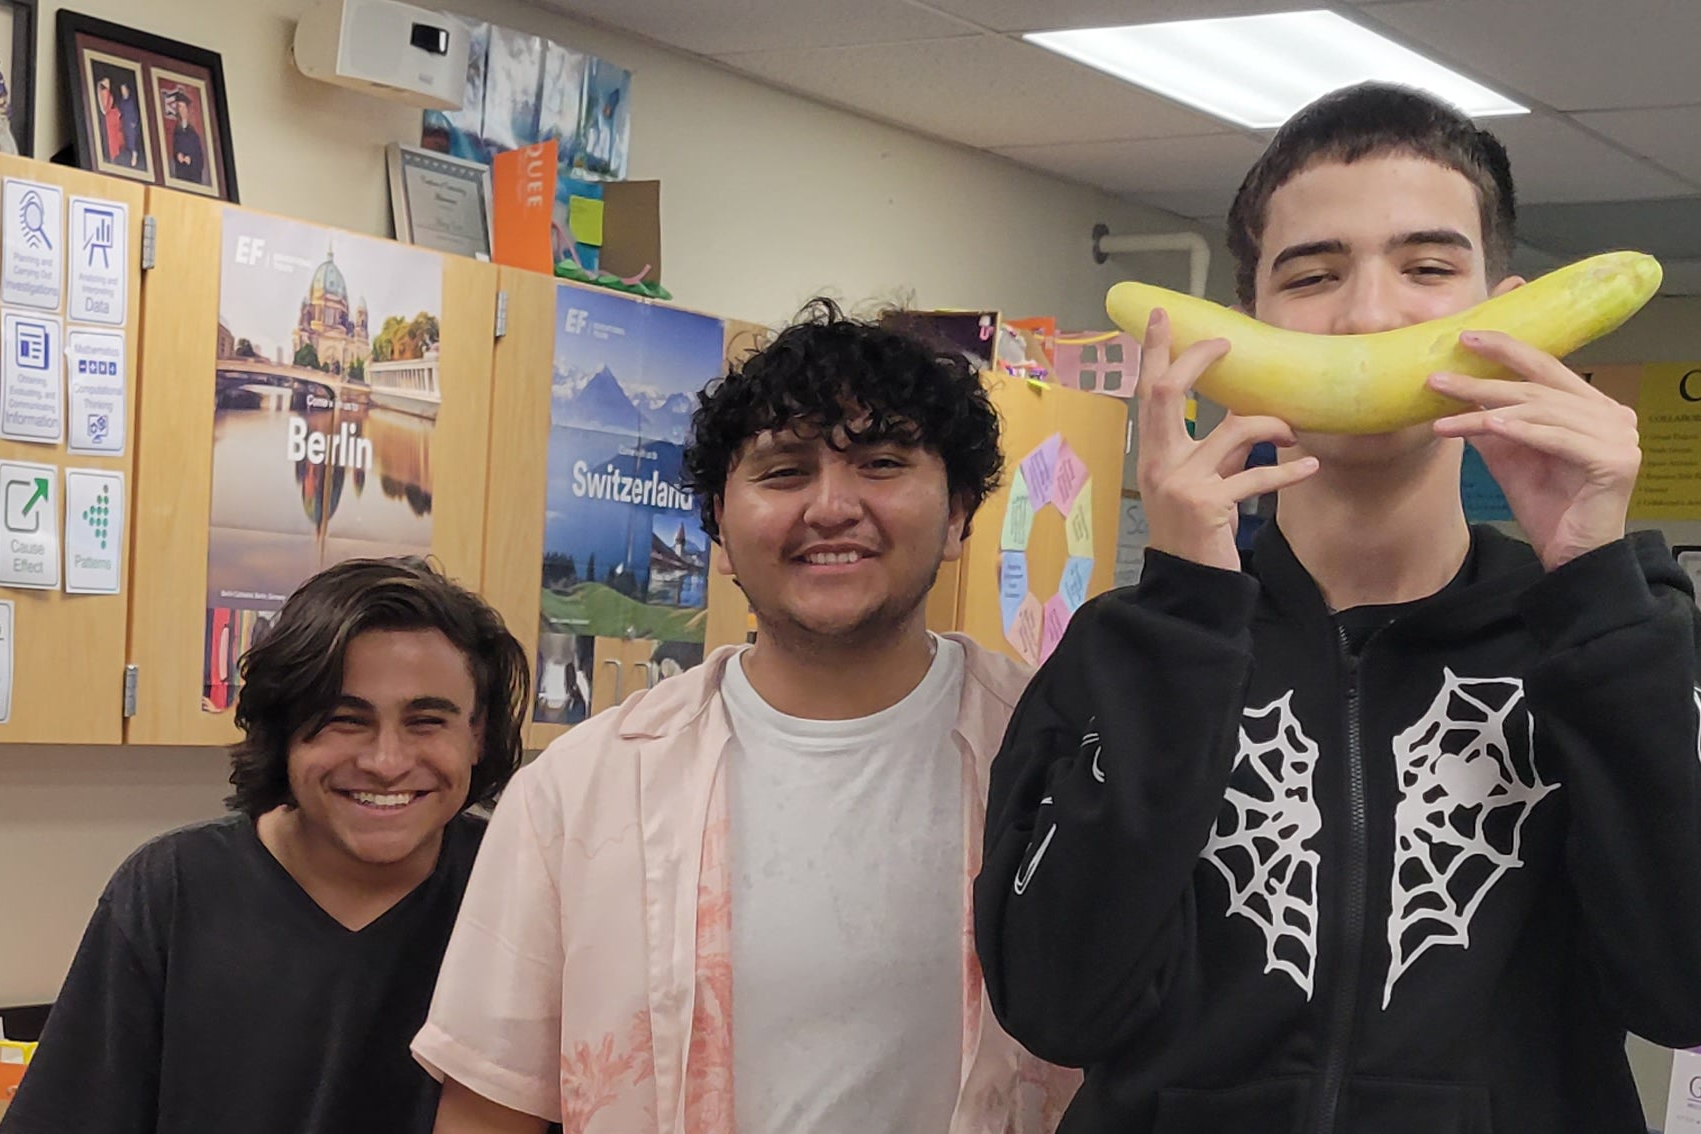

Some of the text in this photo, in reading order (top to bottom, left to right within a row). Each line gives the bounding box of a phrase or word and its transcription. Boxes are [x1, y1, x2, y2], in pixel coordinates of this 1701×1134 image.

[234, 235, 266, 265] EF
[85, 297, 110, 314] Data
[564, 308, 589, 334] EF
[287, 417, 373, 469] Berlin
[572, 460, 693, 510] Switzerland
[10, 539, 45, 556] Cause
[13, 558, 44, 574] Effect
